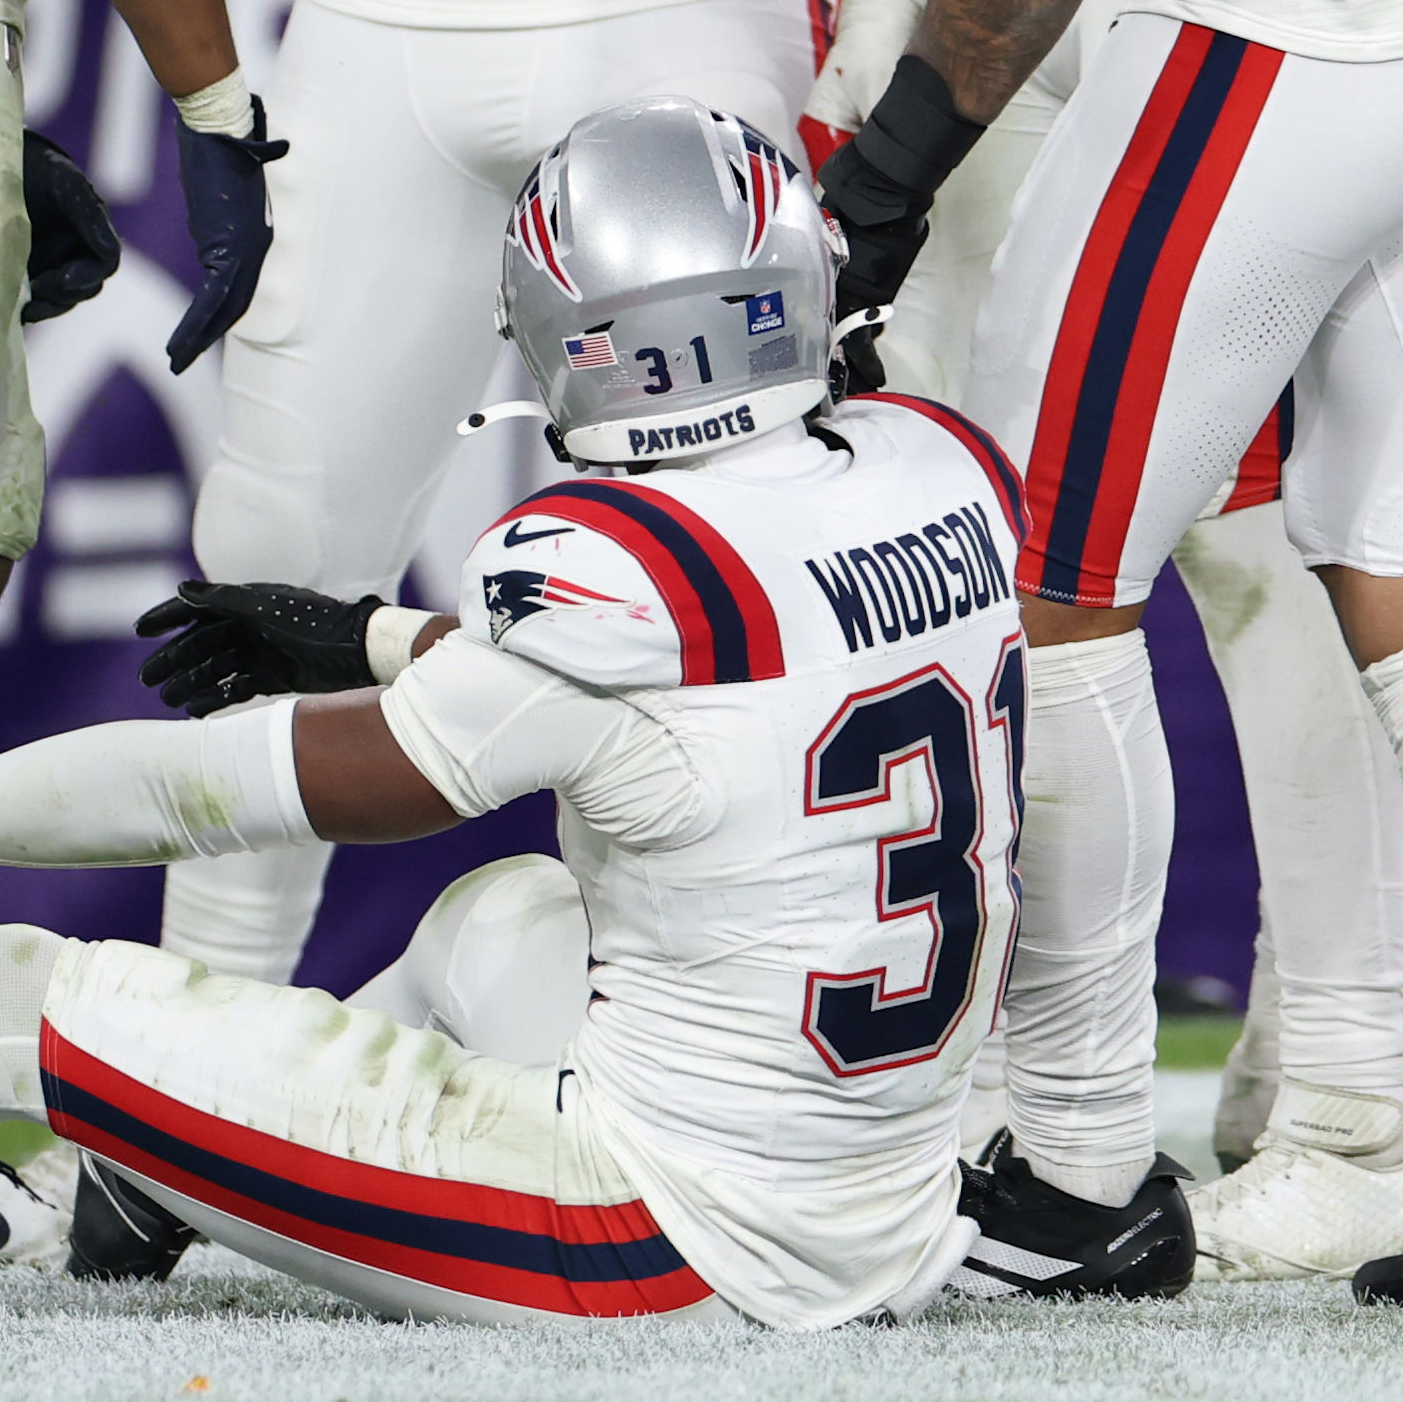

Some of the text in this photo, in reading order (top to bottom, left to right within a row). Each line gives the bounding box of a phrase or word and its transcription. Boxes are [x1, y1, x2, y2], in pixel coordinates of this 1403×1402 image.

[634, 335, 713, 395] 31
[628, 404, 756, 456] PATRIOTS
[804, 501, 1010, 653] WOODSON
